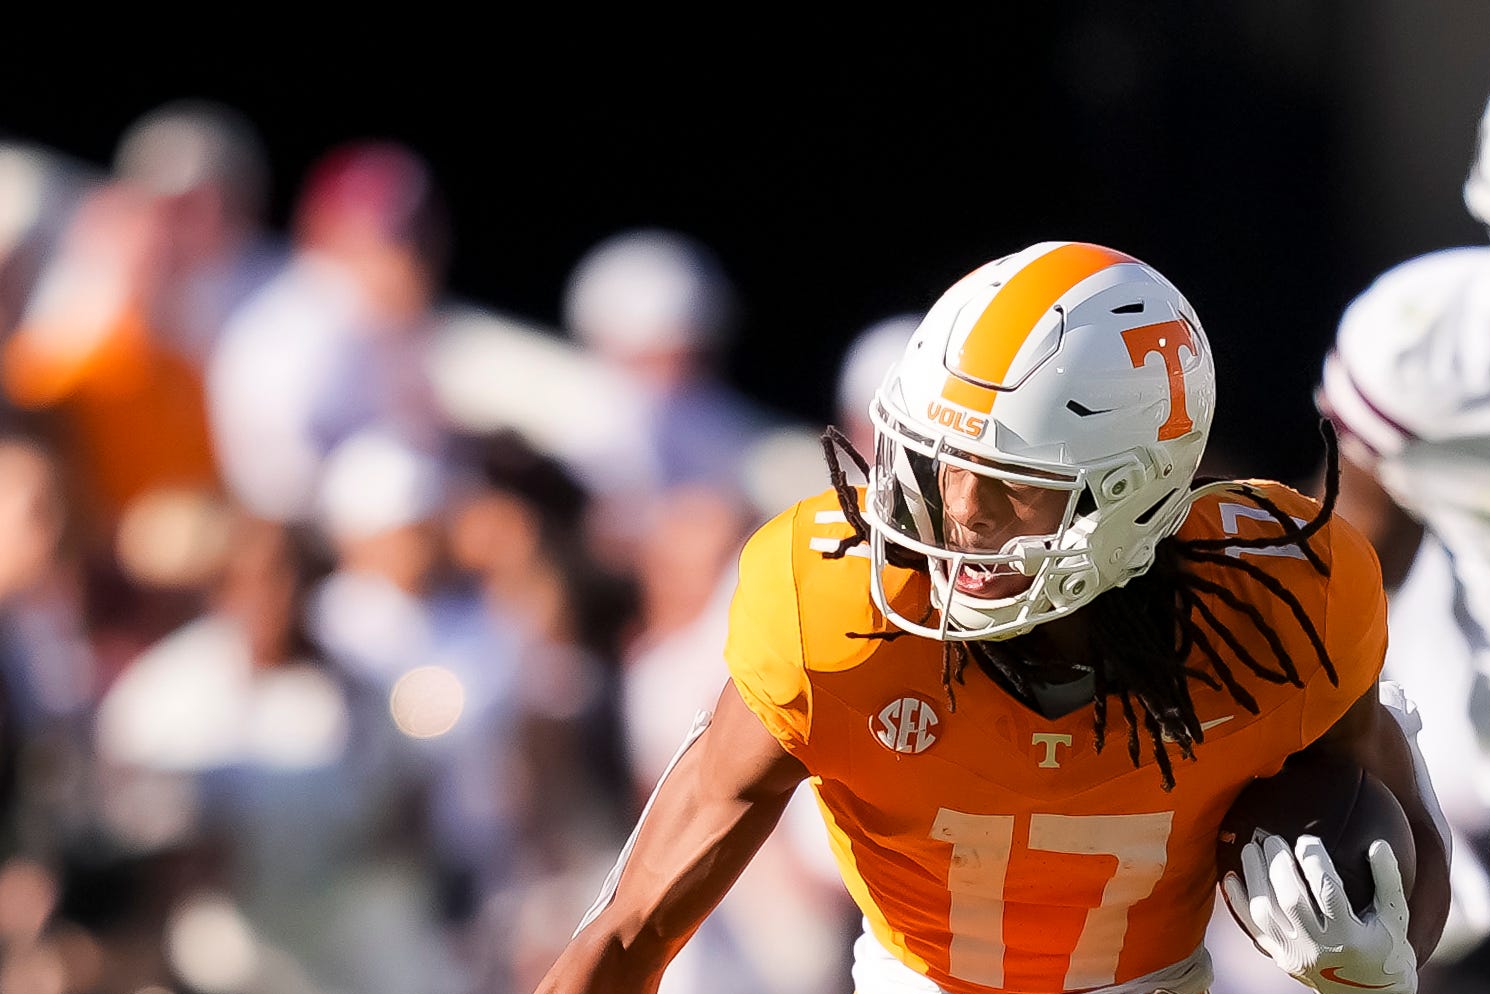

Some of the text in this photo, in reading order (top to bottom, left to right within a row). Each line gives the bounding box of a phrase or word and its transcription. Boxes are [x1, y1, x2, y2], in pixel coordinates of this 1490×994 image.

[1120, 318, 1198, 442] T
[927, 401, 985, 437] VOLS
[877, 697, 939, 754] SEC
[1031, 732, 1073, 769] T
[928, 806, 1176, 992] 17
